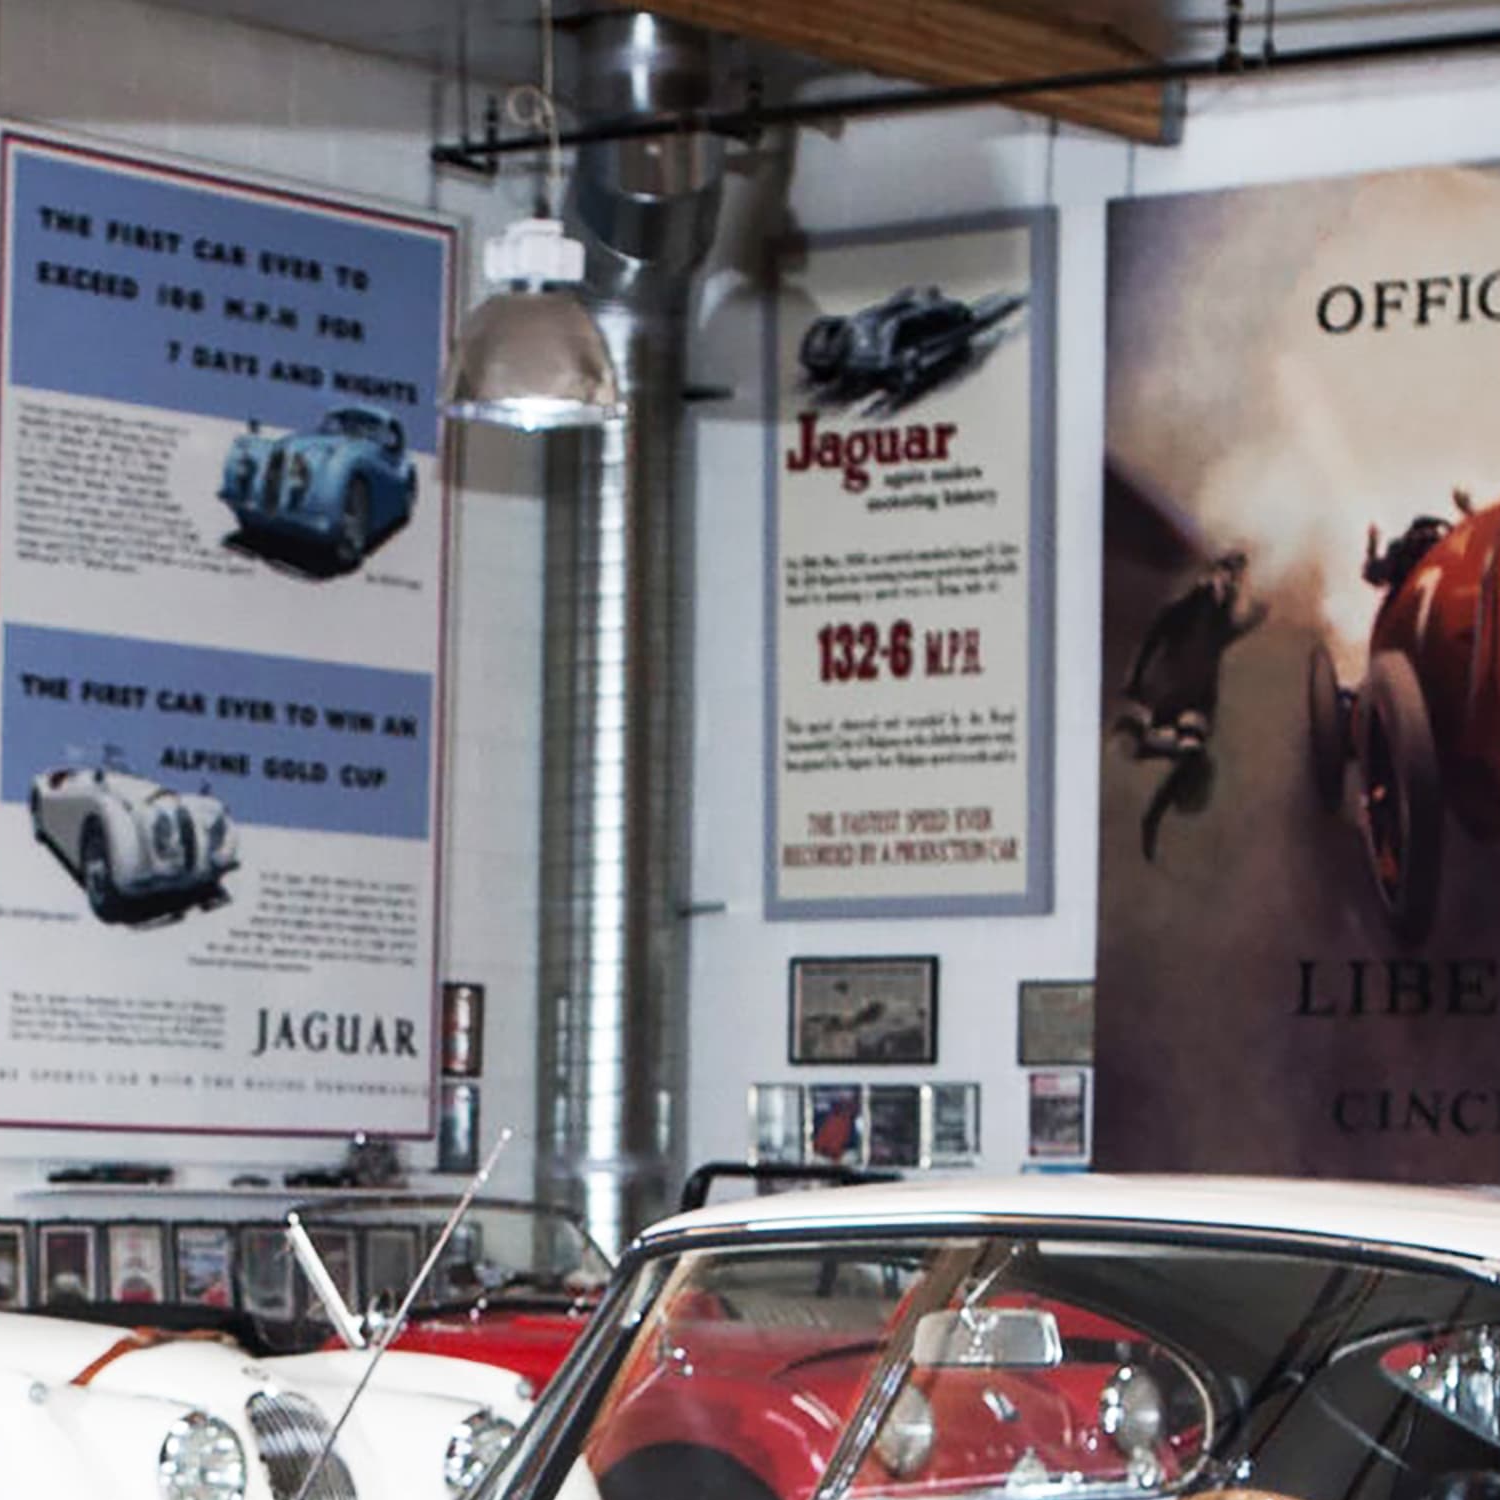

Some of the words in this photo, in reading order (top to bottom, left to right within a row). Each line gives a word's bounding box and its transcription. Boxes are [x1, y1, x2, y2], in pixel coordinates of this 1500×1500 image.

[37, 206, 91, 238] THE
[107, 220, 182, 254] FIRST
[194, 237, 246, 267] CAR
[258, 250, 322, 282] EVER
[334, 264, 370, 292] TO
[36, 260, 139, 300] EXCEED
[157, 283, 205, 312] 100
[317, 313, 365, 343] FOR
[167, 338, 182, 363] 7
[192, 344, 259, 379] DAYS
[269, 361, 324, 389] AND
[331, 370, 419, 404] NIGHTS
[787, 412, 958, 494] Jaguar
[884, 470, 926, 490] again
[932, 466, 983, 482] makes
[867, 494, 938, 513] motoring
[944, 488, 997, 507] history
[21, 672, 70, 699] THE
[80, 680, 148, 711] FIRST
[156, 688, 206, 717] CAR
[217, 695, 276, 724] EVER
[286, 703, 317, 728] TO
[324, 709, 376, 734] WIN
[382, 713, 418, 738] AN
[161, 747, 250, 776] ALPINE
[263, 756, 327, 784] GOLD
[338, 763, 388, 790] CUP
[808, 813, 835, 837] THE
[841, 809, 900, 835] FASTEST
[906, 808, 949, 833] SPEED
[955, 806, 992, 832] EVER
[783, 844, 854, 867] RECORDED
[860, 842, 877, 865] BY
[881, 842, 891, 863] A
[896, 837, 986, 864] PRODUCTION
[990, 835, 1018, 862] CAR
[251, 1008, 419, 1058] JAGUAR
